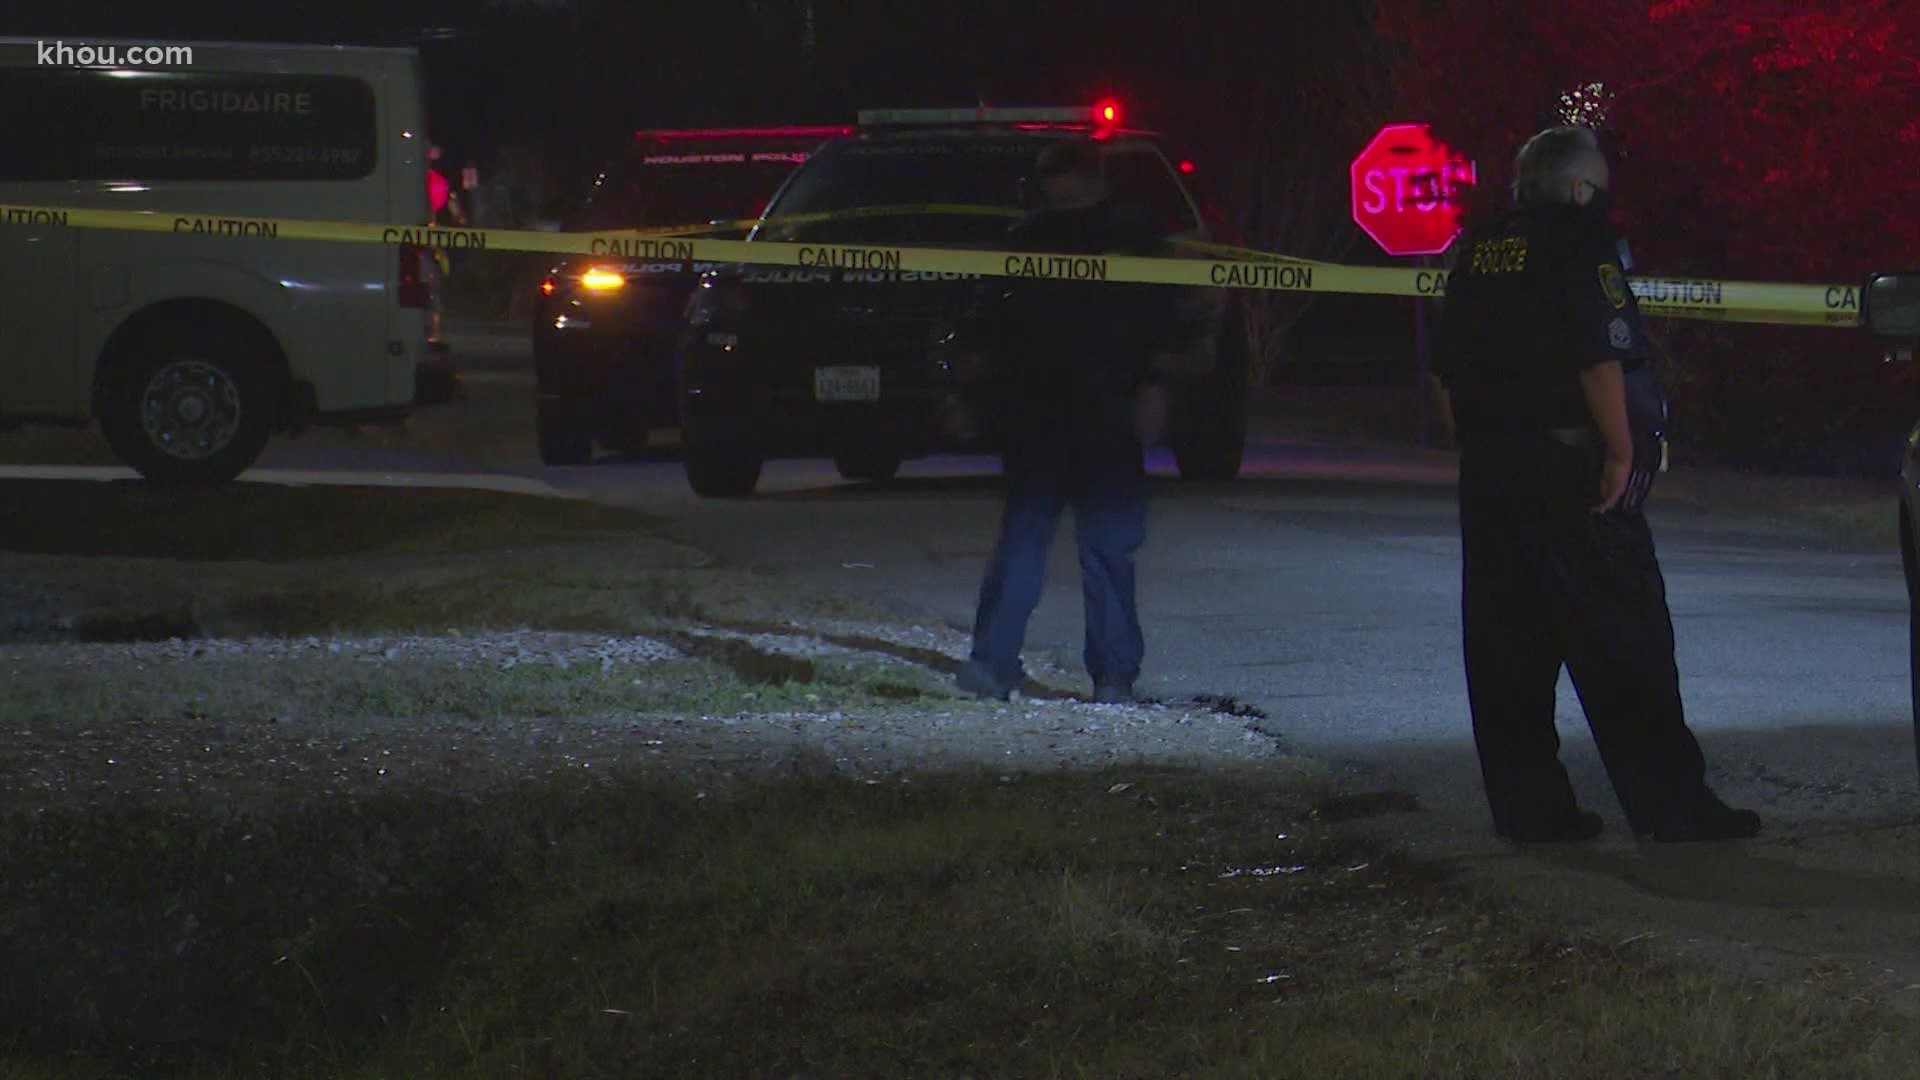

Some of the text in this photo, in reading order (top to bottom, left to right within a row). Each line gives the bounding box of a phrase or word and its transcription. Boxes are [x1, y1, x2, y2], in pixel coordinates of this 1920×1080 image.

[140, 89, 312, 115] FRIGIDAIRE
[174, 217, 278, 238] CAUTION
[383, 228, 486, 249] CAUTION
[591, 238, 693, 261] CAUTION
[799, 246, 900, 271] CAUTION
[1004, 255, 1107, 281] CAUTION
[1210, 263, 1312, 289] CAUTION
[1472, 249, 1528, 274] POLICE
